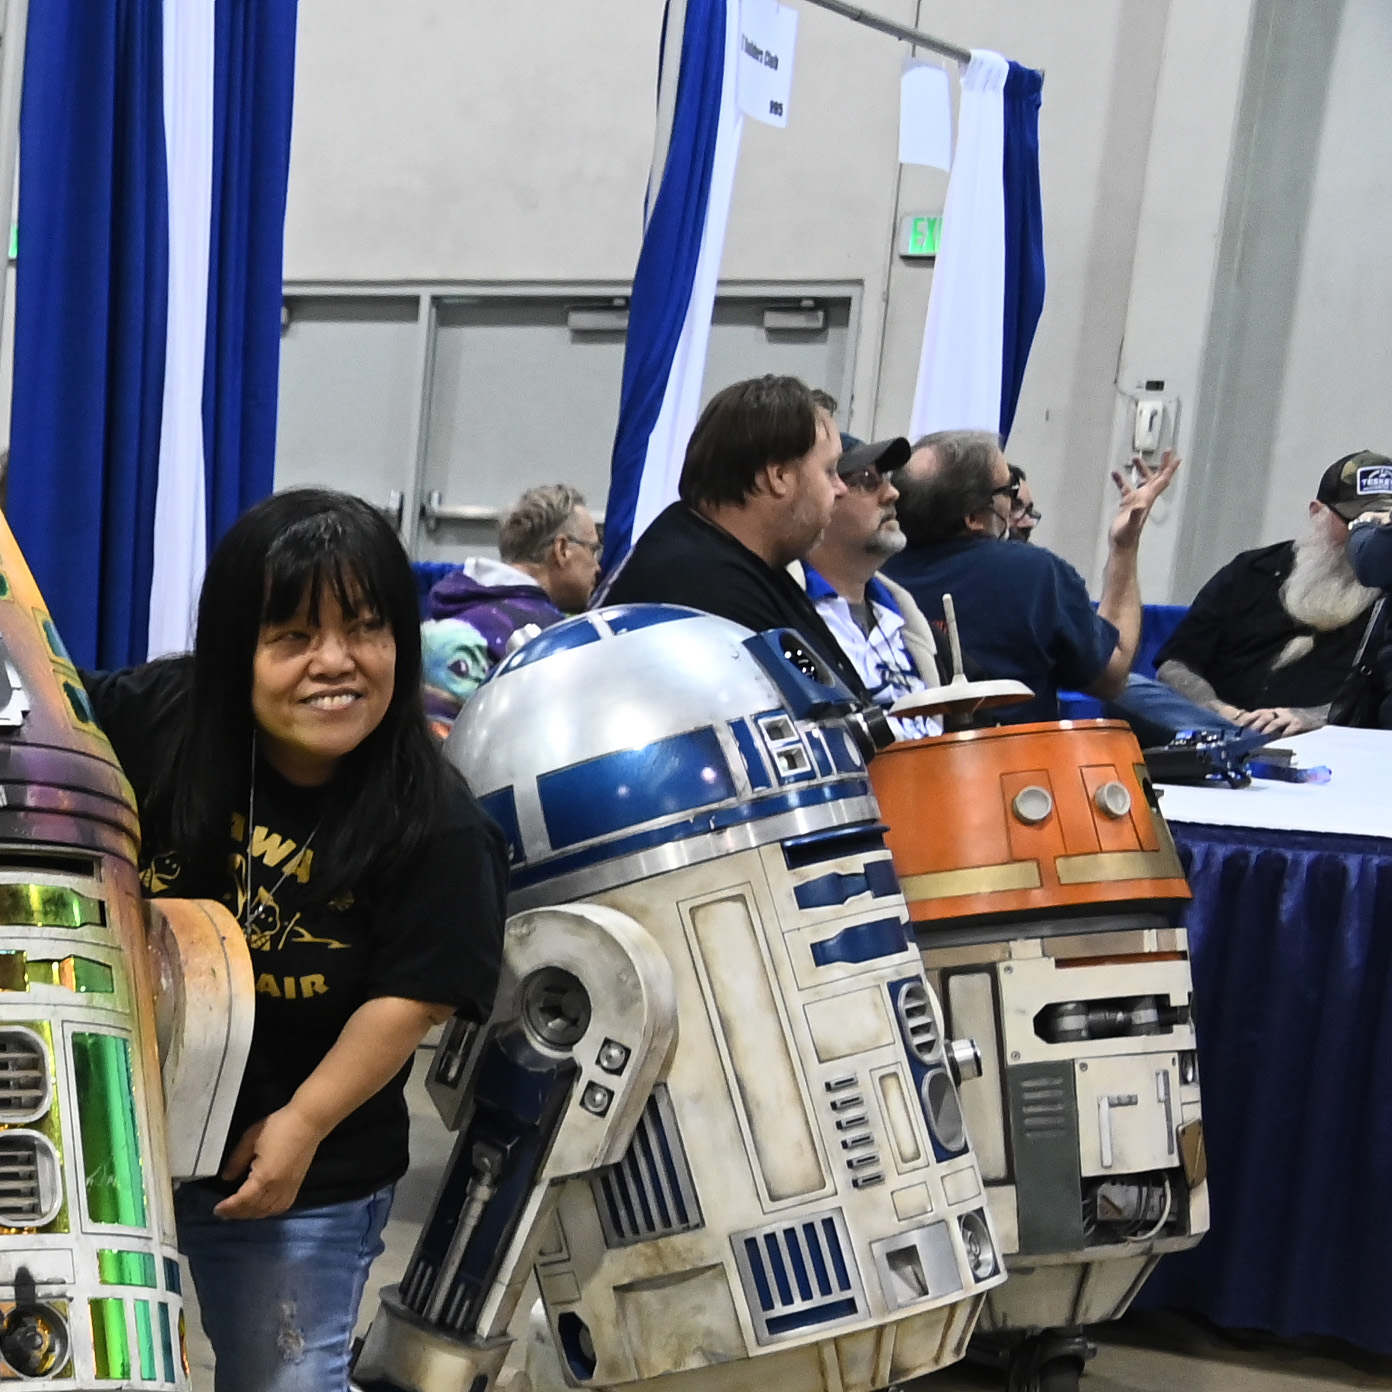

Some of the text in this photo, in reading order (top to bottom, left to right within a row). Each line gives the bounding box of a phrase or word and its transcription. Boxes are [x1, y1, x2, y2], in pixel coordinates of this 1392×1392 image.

[909, 217, 943, 253] EXI
[231, 812, 314, 884] AWA
[256, 973, 329, 999] AIR
